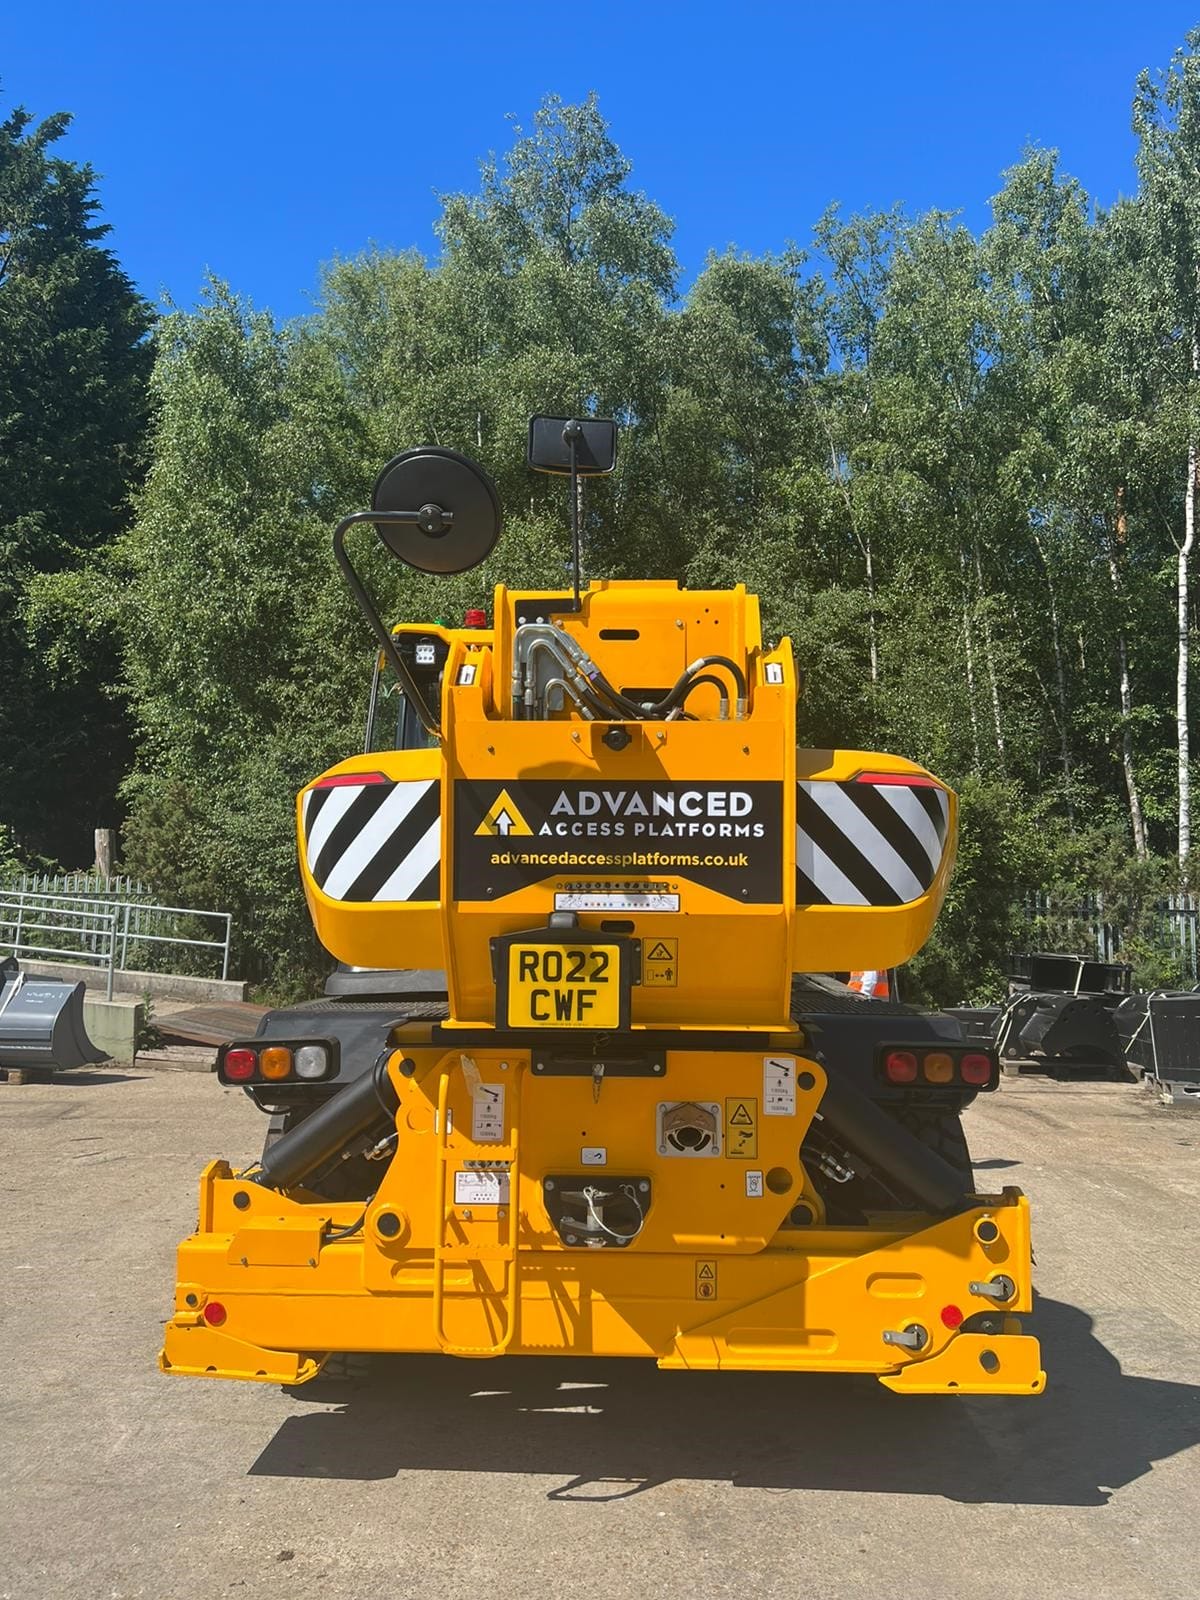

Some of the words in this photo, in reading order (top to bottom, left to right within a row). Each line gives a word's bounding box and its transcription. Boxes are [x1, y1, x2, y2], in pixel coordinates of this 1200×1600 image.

[550, 790, 753, 817] ADVANCED
[538, 821, 626, 837] ACCESS
[634, 822, 765, 838] PLATFORMS
[490, 851, 749, 868] advancedaccessplatforms.co.uk
[518, 950, 610, 983] RO22
[529, 988, 598, 1022] CWF
